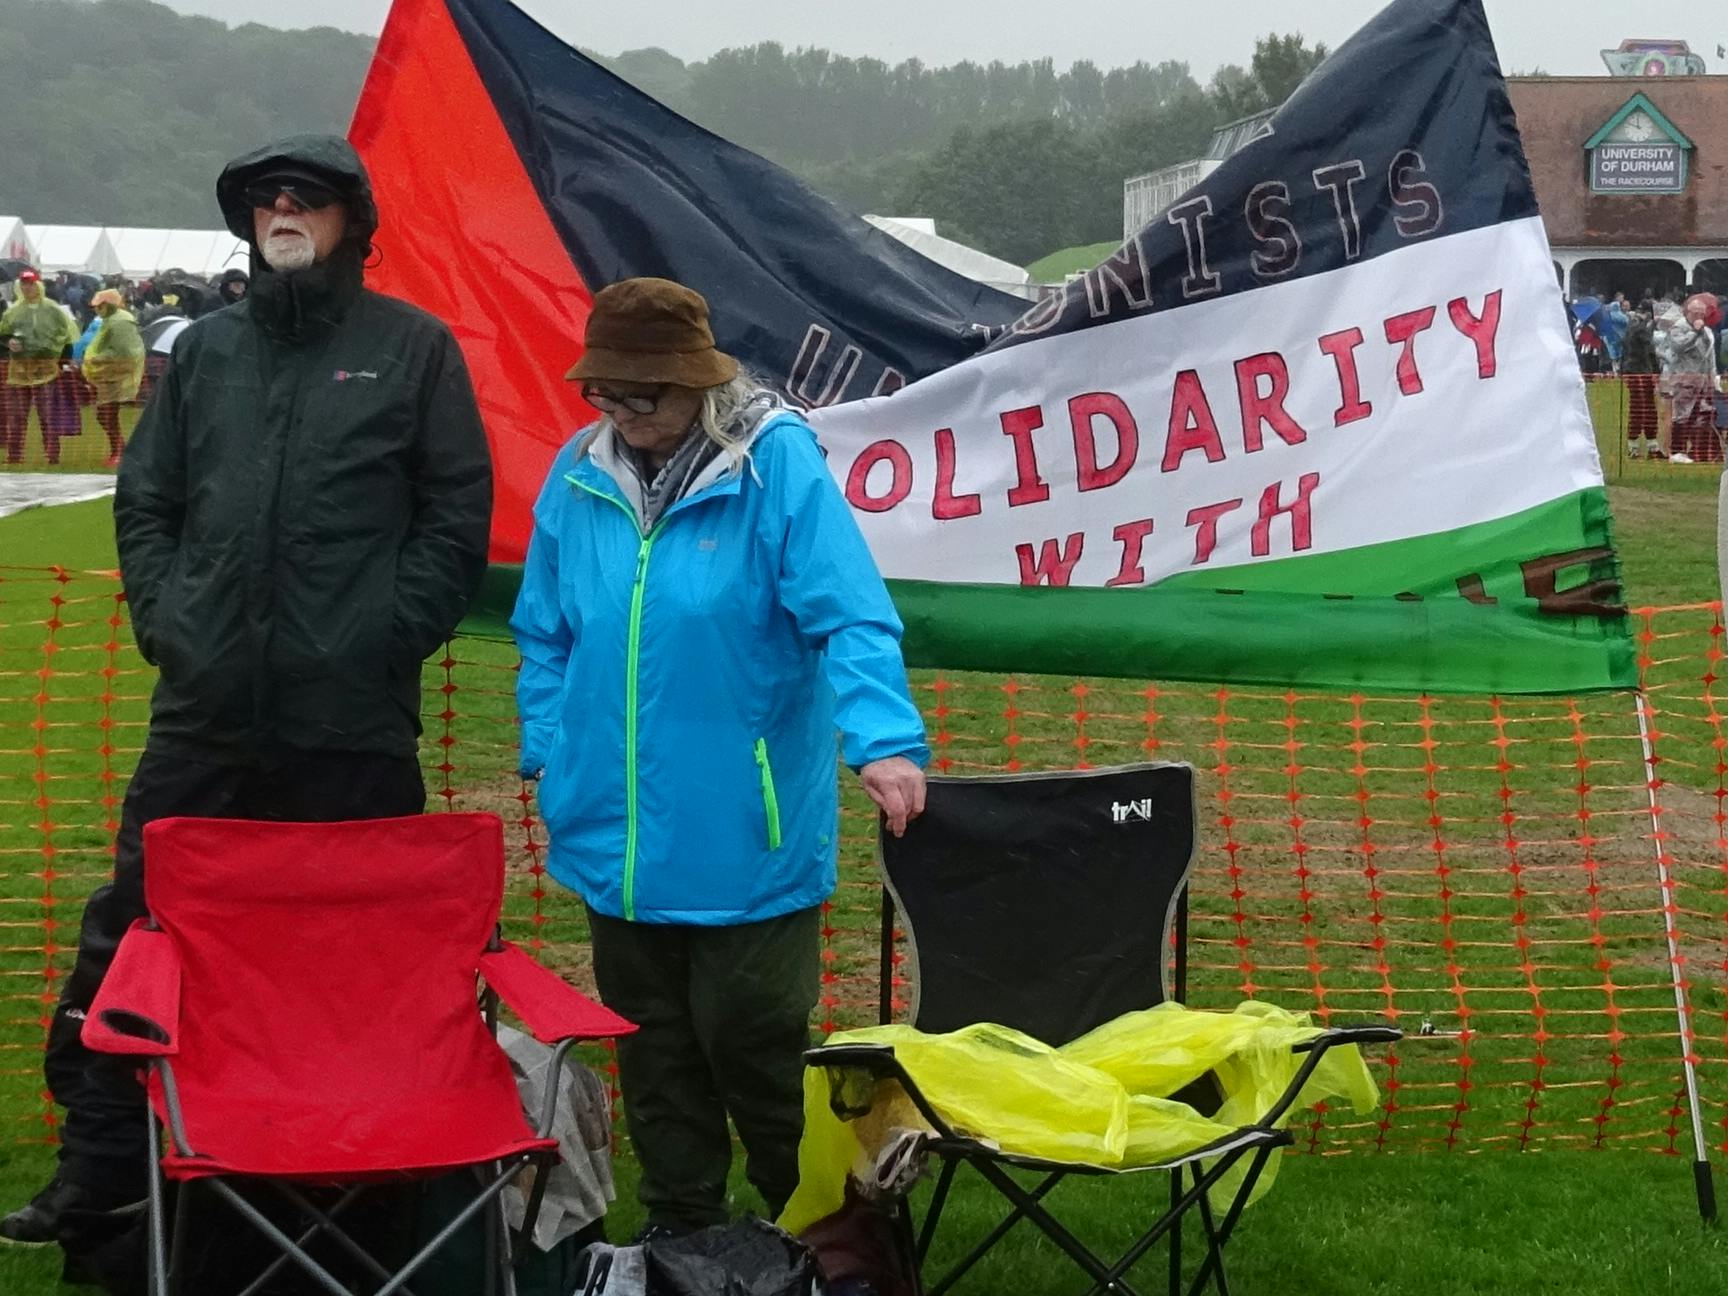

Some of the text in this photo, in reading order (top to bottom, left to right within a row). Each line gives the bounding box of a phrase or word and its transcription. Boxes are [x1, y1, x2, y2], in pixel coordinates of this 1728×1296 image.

[1601, 148, 1673, 159] UNIVERSITY
[1601, 161, 1674, 172] OF DURHAM
[1600, 177, 1674, 185] THE RACECOURSE
[845, 288, 1503, 521] OLIDARITY
[1014, 471, 1320, 589] WITH
